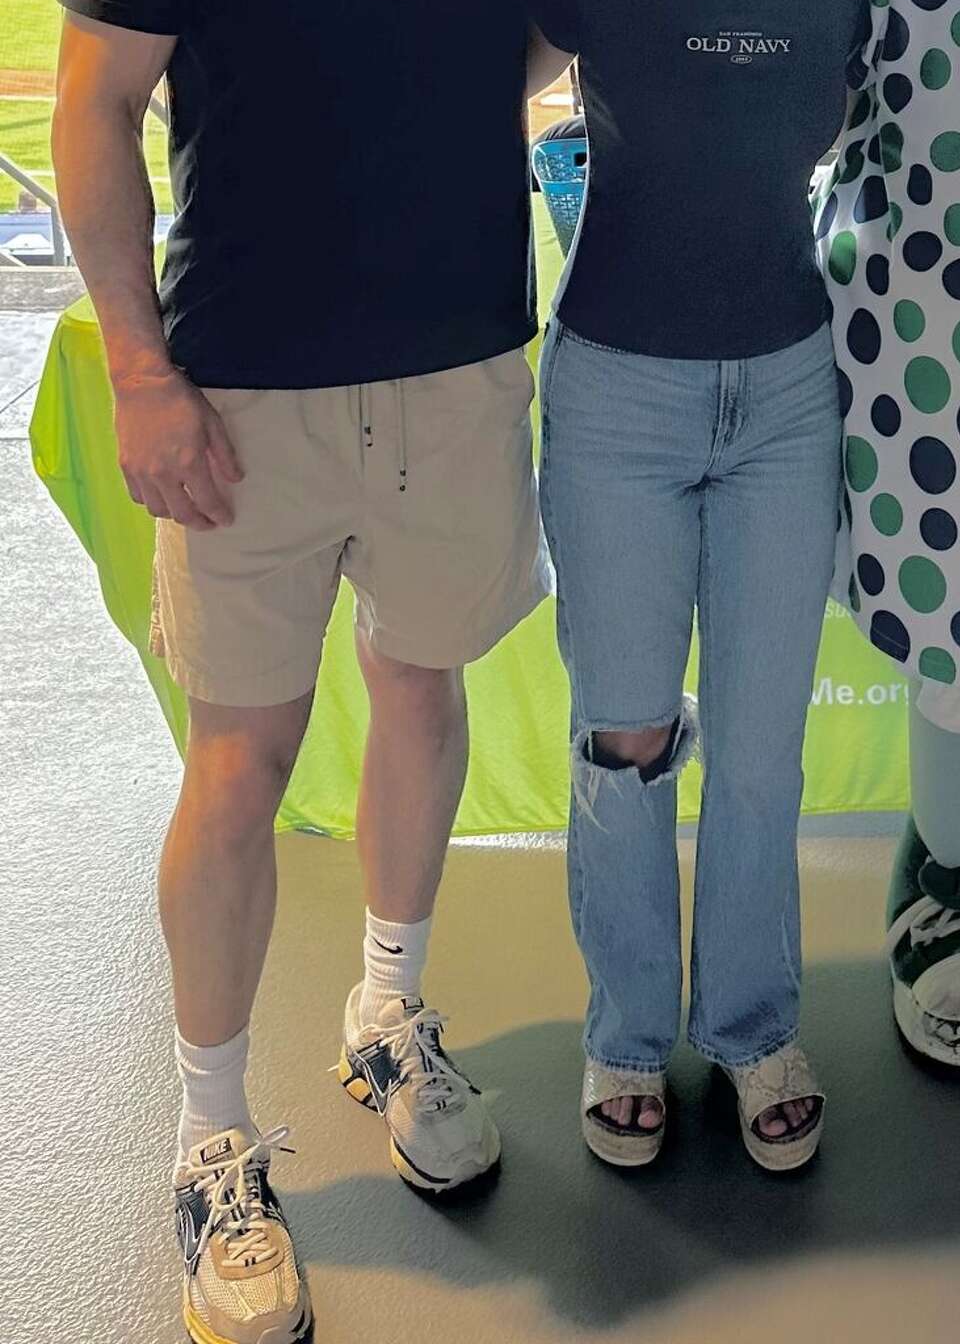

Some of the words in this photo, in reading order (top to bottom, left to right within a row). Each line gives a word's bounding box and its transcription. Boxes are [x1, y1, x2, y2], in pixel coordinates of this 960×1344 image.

[686, 37, 731, 53] OLD
[738, 39, 791, 54] NAVY
[810, 677, 910, 706] Me.or
